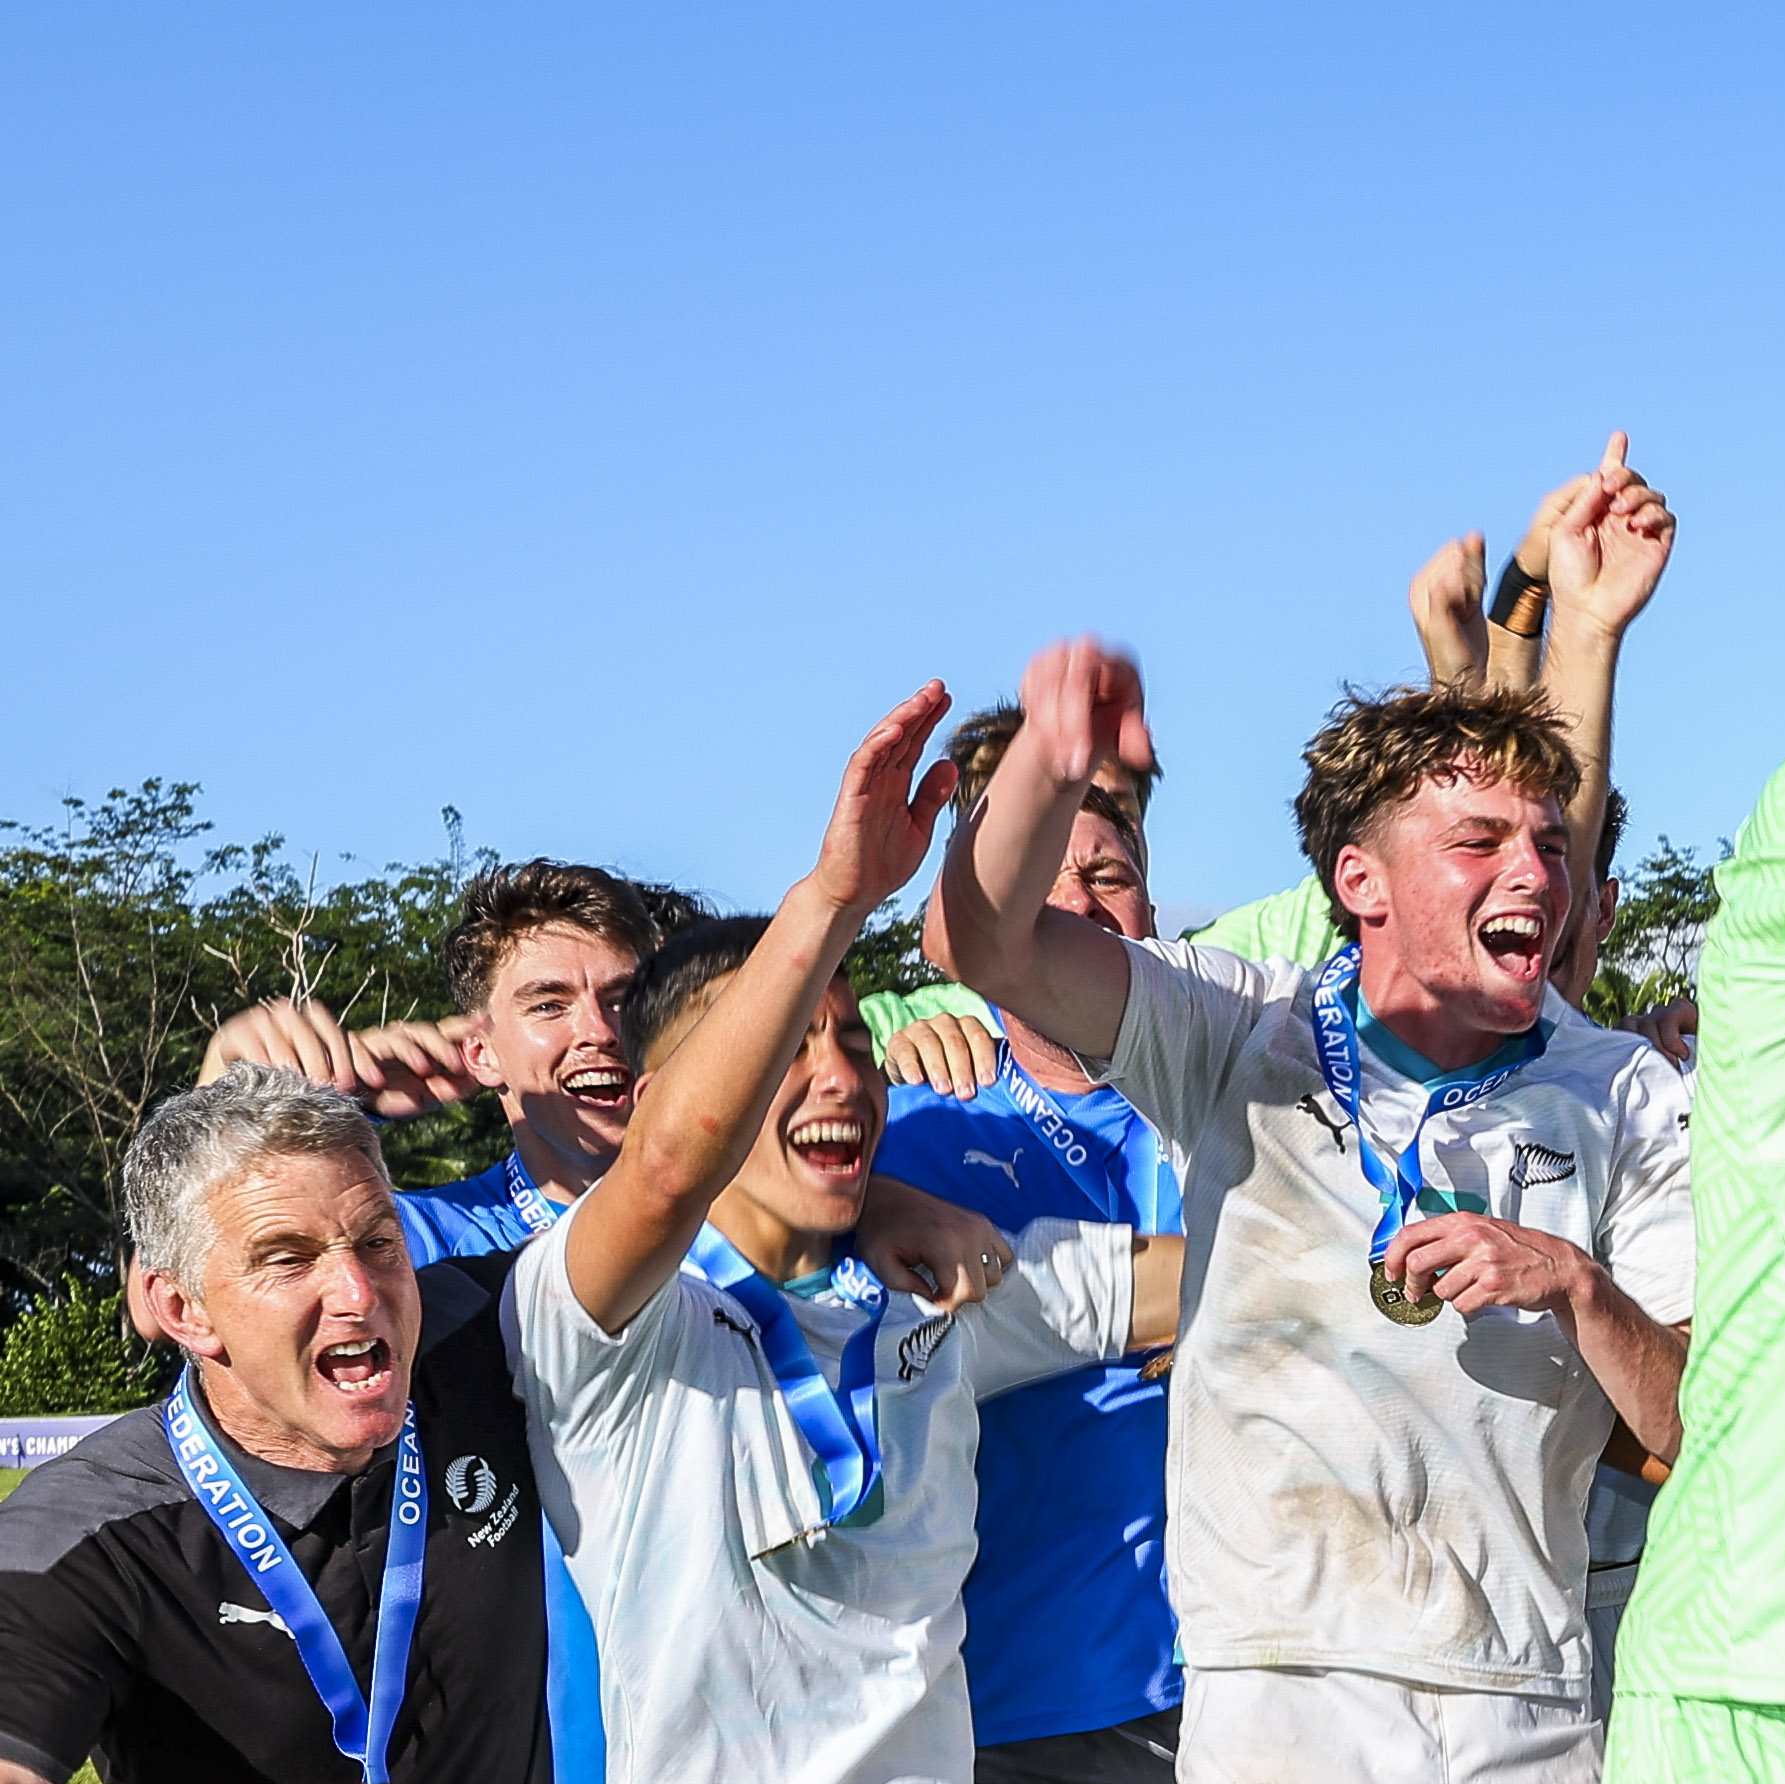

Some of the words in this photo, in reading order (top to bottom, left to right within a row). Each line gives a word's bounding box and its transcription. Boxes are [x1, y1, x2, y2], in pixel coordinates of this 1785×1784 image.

[25, 1435, 85, 1455] CHAMP
[398, 1399, 421, 1525] OCEAN
[467, 1523, 493, 1548] New
[489, 1483, 519, 1525] Zealand
[486, 1506, 519, 1548] Football
